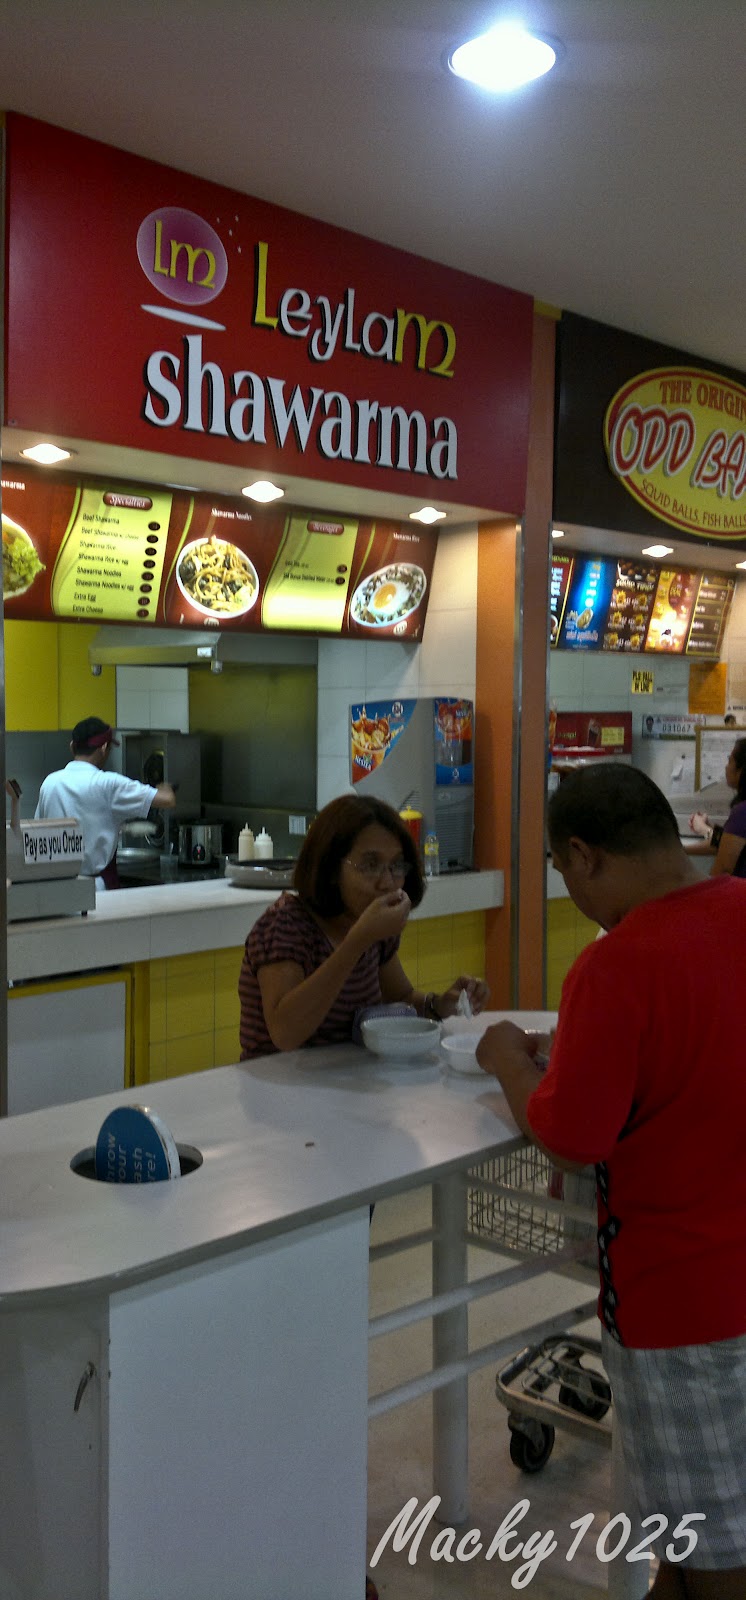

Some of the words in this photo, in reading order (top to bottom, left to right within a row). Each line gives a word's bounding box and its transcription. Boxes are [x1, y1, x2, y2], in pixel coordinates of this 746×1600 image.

[144, 334, 458, 480] shawarma
[660, 380, 692, 405] THE
[611, 401, 696, 476] ODD
[642, 478, 671, 508] SQUID
[703, 511, 721, 527] FISH
[74, 592, 87, 600] Extra
[24, 832, 38, 861] Pay
[39, 836, 48, 855] as
[48, 836, 61, 861] you
[62, 830, 83, 854] Order
